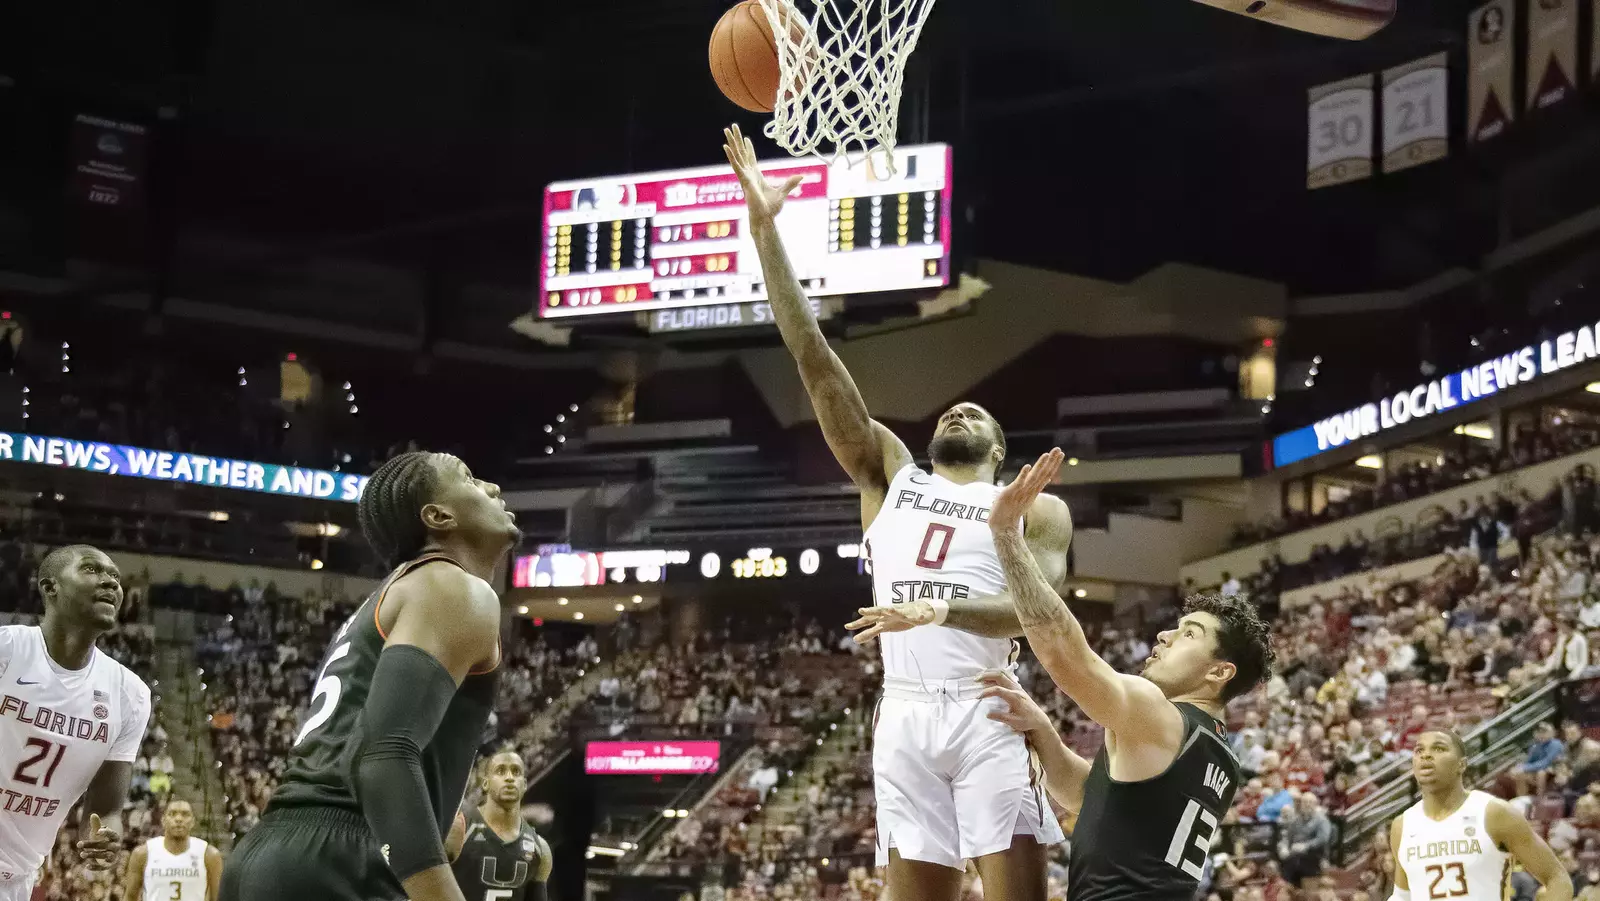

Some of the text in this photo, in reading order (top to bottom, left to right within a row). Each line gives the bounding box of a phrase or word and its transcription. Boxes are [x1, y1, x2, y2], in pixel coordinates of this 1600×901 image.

[1316, 114, 1363, 152] 30
[1396, 94, 1433, 134] 21
[658, 305, 742, 329] FLORIDA
[1313, 403, 1379, 450] YOUR
[1381, 378, 1457, 429] LOCAL
[1461, 346, 1537, 401] NEWS
[22, 435, 121, 475] NEWS,
[128, 450, 264, 490] WEATHER
[271, 468, 336, 498] AND
[800, 549, 820, 574] 0
[916, 523, 956, 569] 0
[700, 553, 721, 578] 0
[730, 557, 787, 580] 19:03
[891, 580, 970, 604] STATE
[0, 694, 109, 744] FLORIDA
[13, 737, 67, 788] 21
[1203, 762, 1231, 800] MACK
[0, 788, 60, 818] TATE
[1164, 798, 1218, 881] 13
[1406, 839, 1482, 862] FLORIDA
[151, 867, 200, 877] FLORIDA
[169, 880, 182, 900] 3
[1425, 862, 1469, 900] 23
